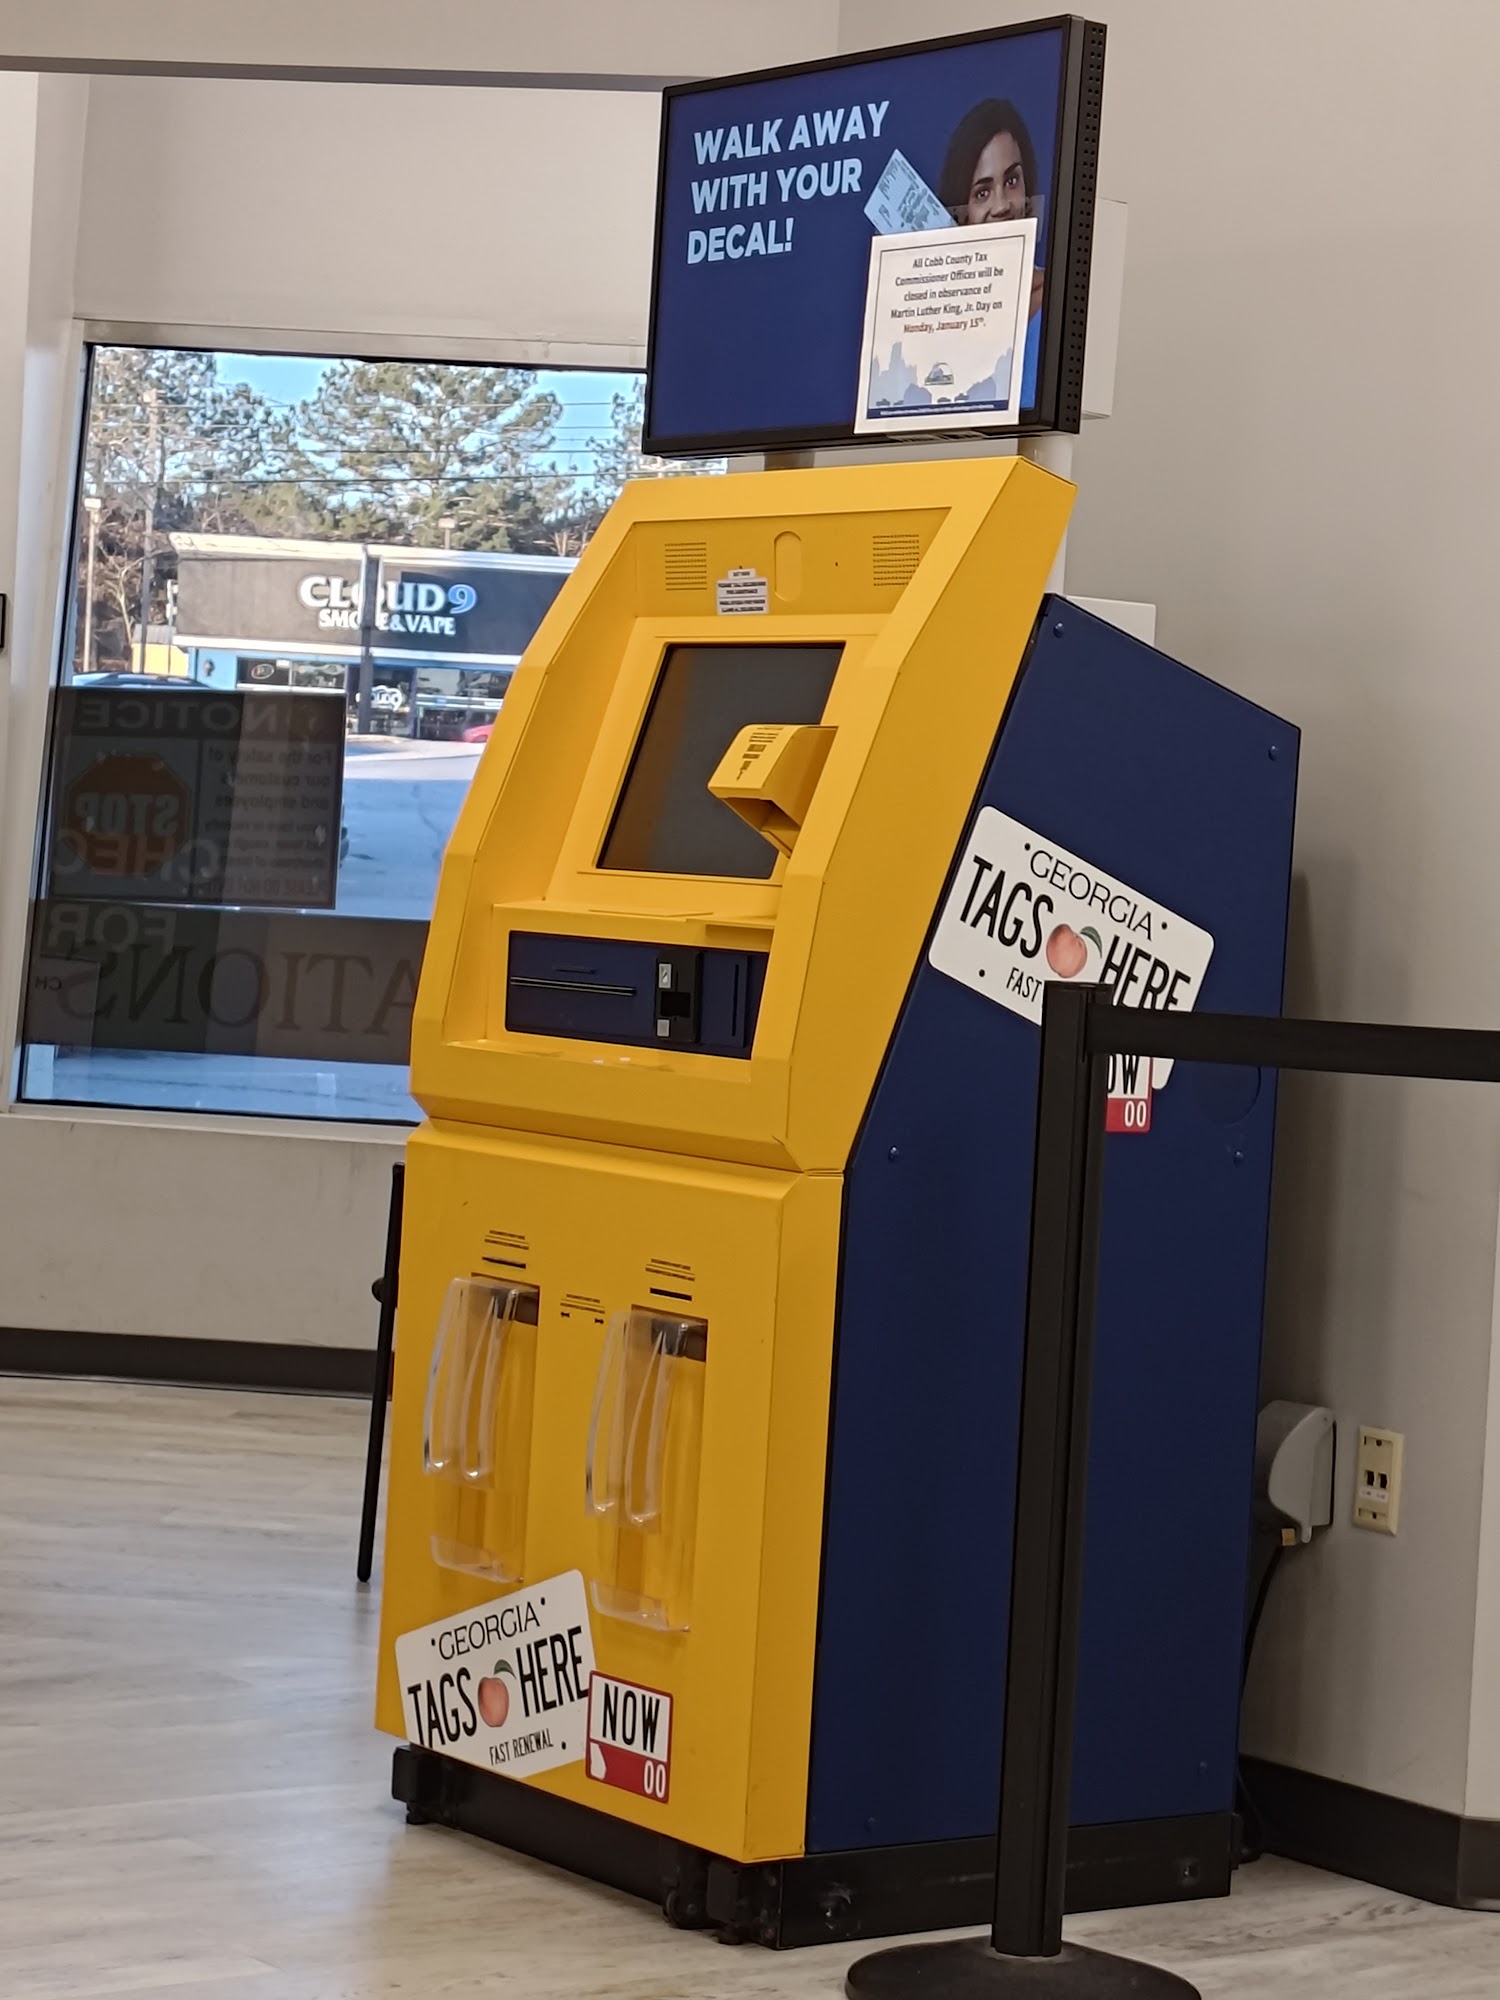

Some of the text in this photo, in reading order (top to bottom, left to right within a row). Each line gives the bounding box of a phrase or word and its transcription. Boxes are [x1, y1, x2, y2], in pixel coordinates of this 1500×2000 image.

[694, 100, 890, 165] WALK AWAY
[691, 172, 769, 214] WITH
[775, 157, 863, 202] YOUR
[687, 217, 793, 265] DECAL!
[912, 252, 988, 268] All Cobb County Tax
[895, 267, 1004, 287] Commissioner Offices will be
[904, 283, 993, 302] closed in observance of
[891, 300, 1003, 319] Martin Luther King, Jr. Day on
[903, 321, 935, 335] Monday,
[935, 319, 968, 332] January
[448, 583, 477, 614] 9
[1030, 850, 1152, 941] GEORGIA
[959, 855, 1191, 1011] TAGS HERE
[1005, 967, 1043, 1002] FAST
[1124, 1100, 1147, 1127] 00
[439, 1601, 541, 1660] GEORGIA
[407, 1625, 589, 1748] TAGS HERE
[602, 1682, 660, 1753] NOW
[489, 1728, 554, 1766] FAST RENEWAL
[643, 1760, 667, 1799] 00
